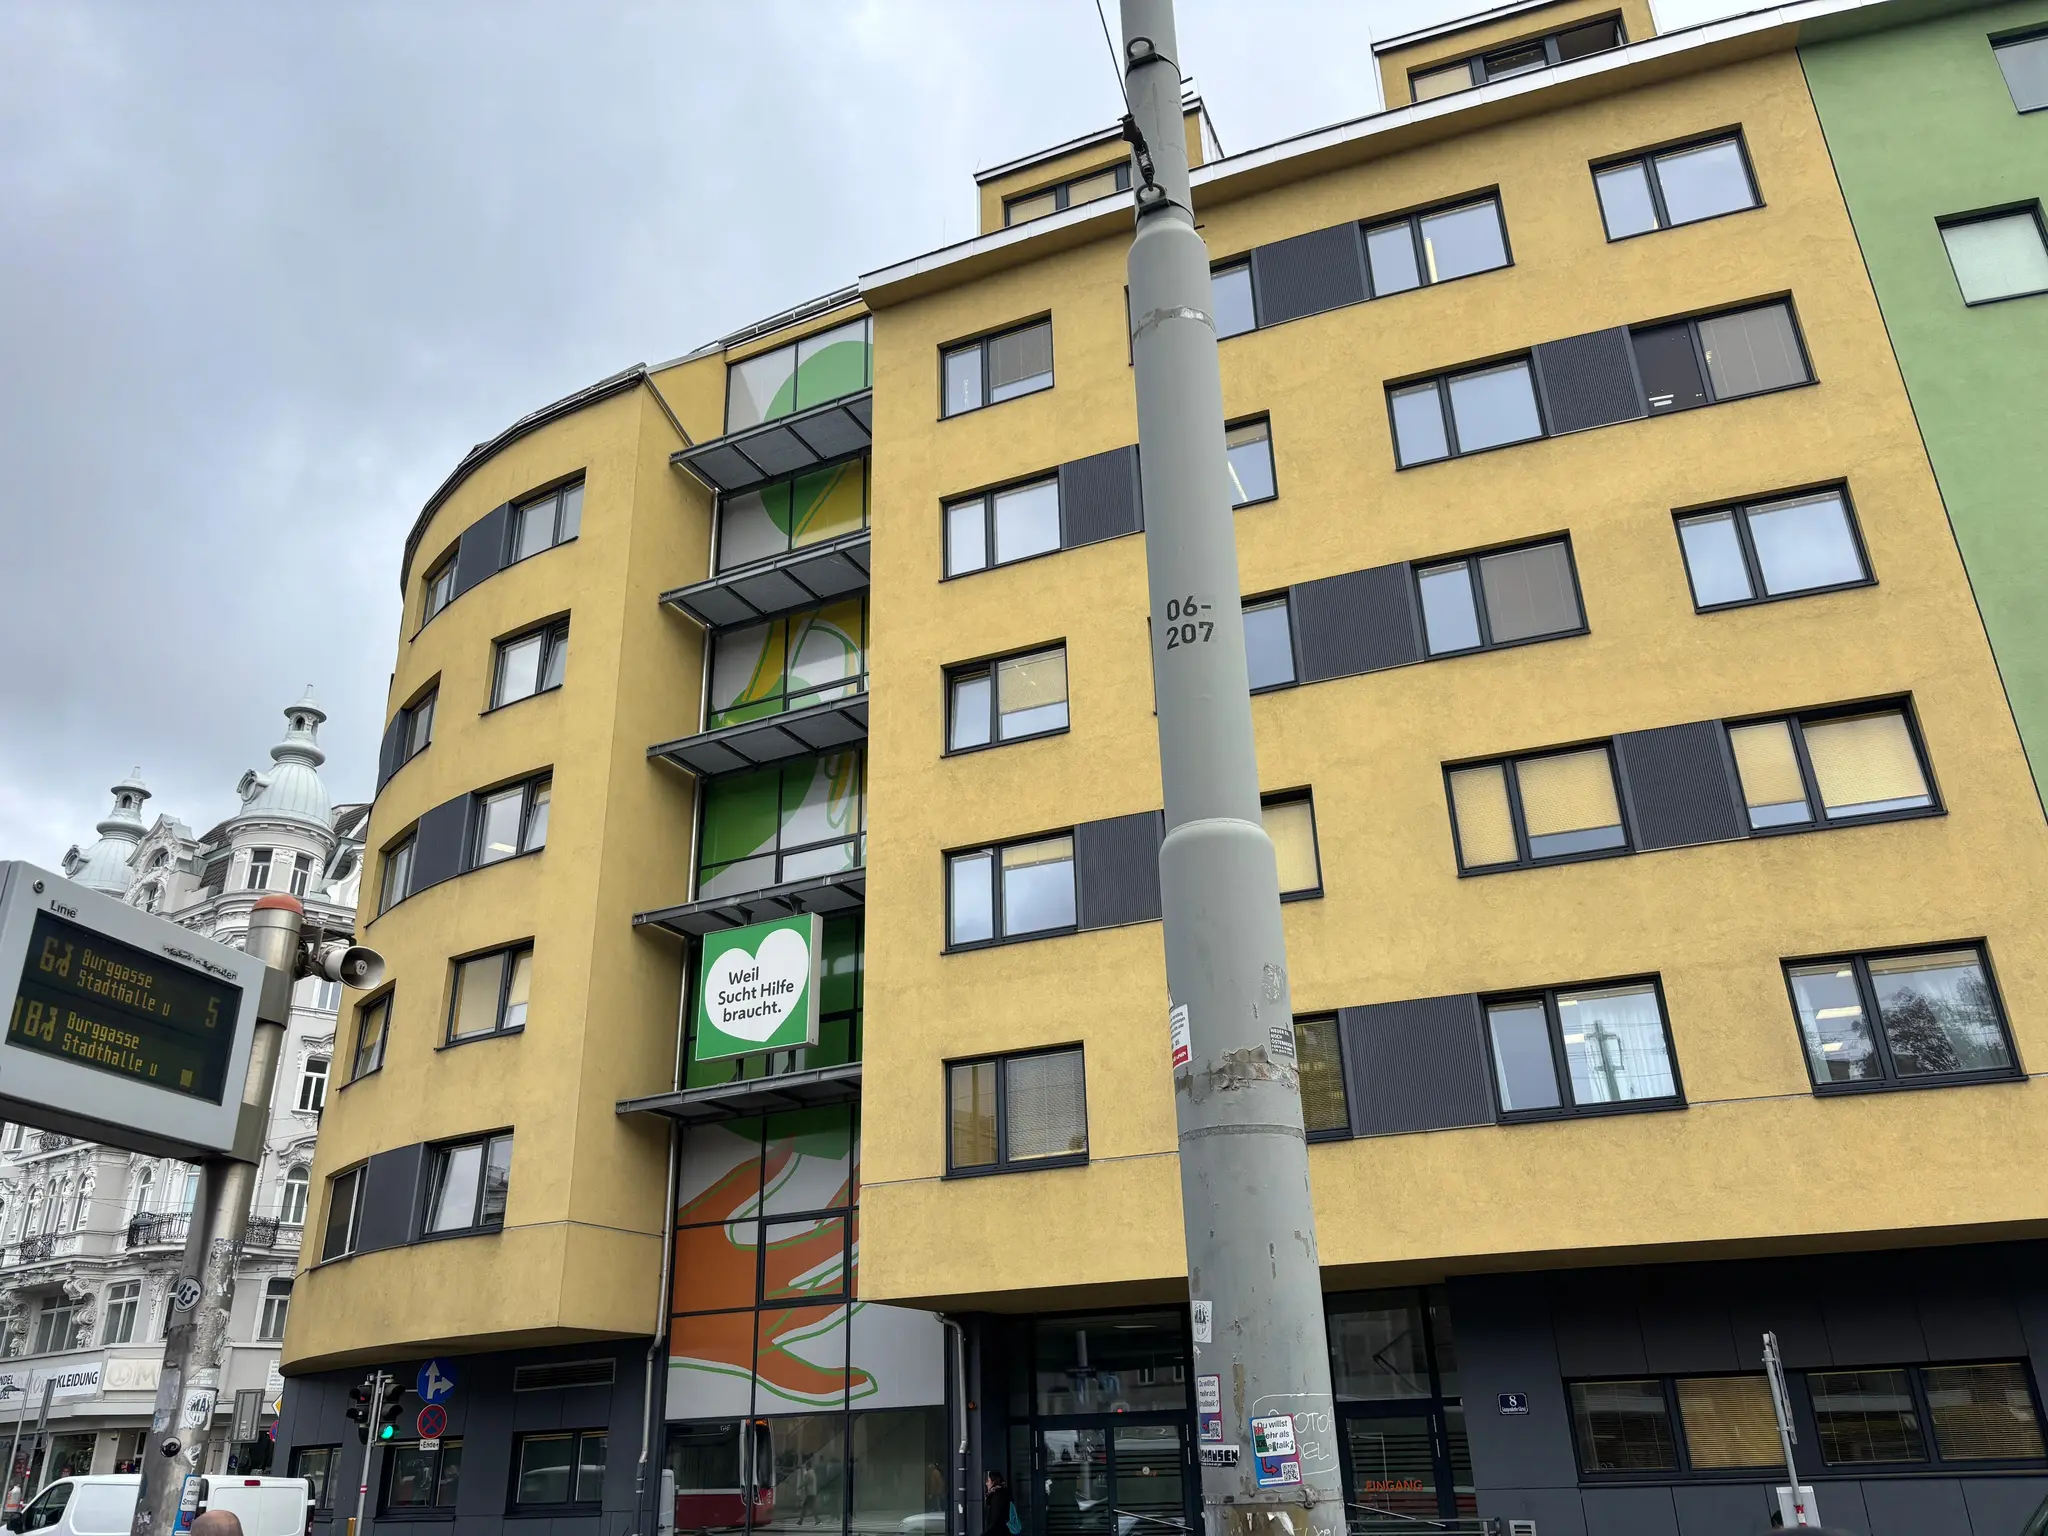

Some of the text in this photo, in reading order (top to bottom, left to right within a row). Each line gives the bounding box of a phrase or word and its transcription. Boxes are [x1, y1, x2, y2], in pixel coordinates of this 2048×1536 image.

[1166, 595, 1212, 622] 06-
[1166, 621, 1214, 650] 207
[81, 949, 153, 989] Burggasse
[728, 966, 760, 985] Weil
[77, 970, 156, 1012] Stadthalle
[718, 979, 795, 1005] Sucht Hilfe
[205, 996, 221, 1028] 5
[723, 1000, 782, 1022] braucht.
[66, 1011, 140, 1050] Burggasse
[62, 1032, 143, 1073] Stadthalle
[56, 1371, 99, 1389] KLEIDUNG
[1508, 1395, 1518, 1407] 8
[1265, 1431, 1279, 1440] ehr
[1268, 1419, 1288, 1429] willst
[1364, 1480, 1424, 1492] EINGANG
